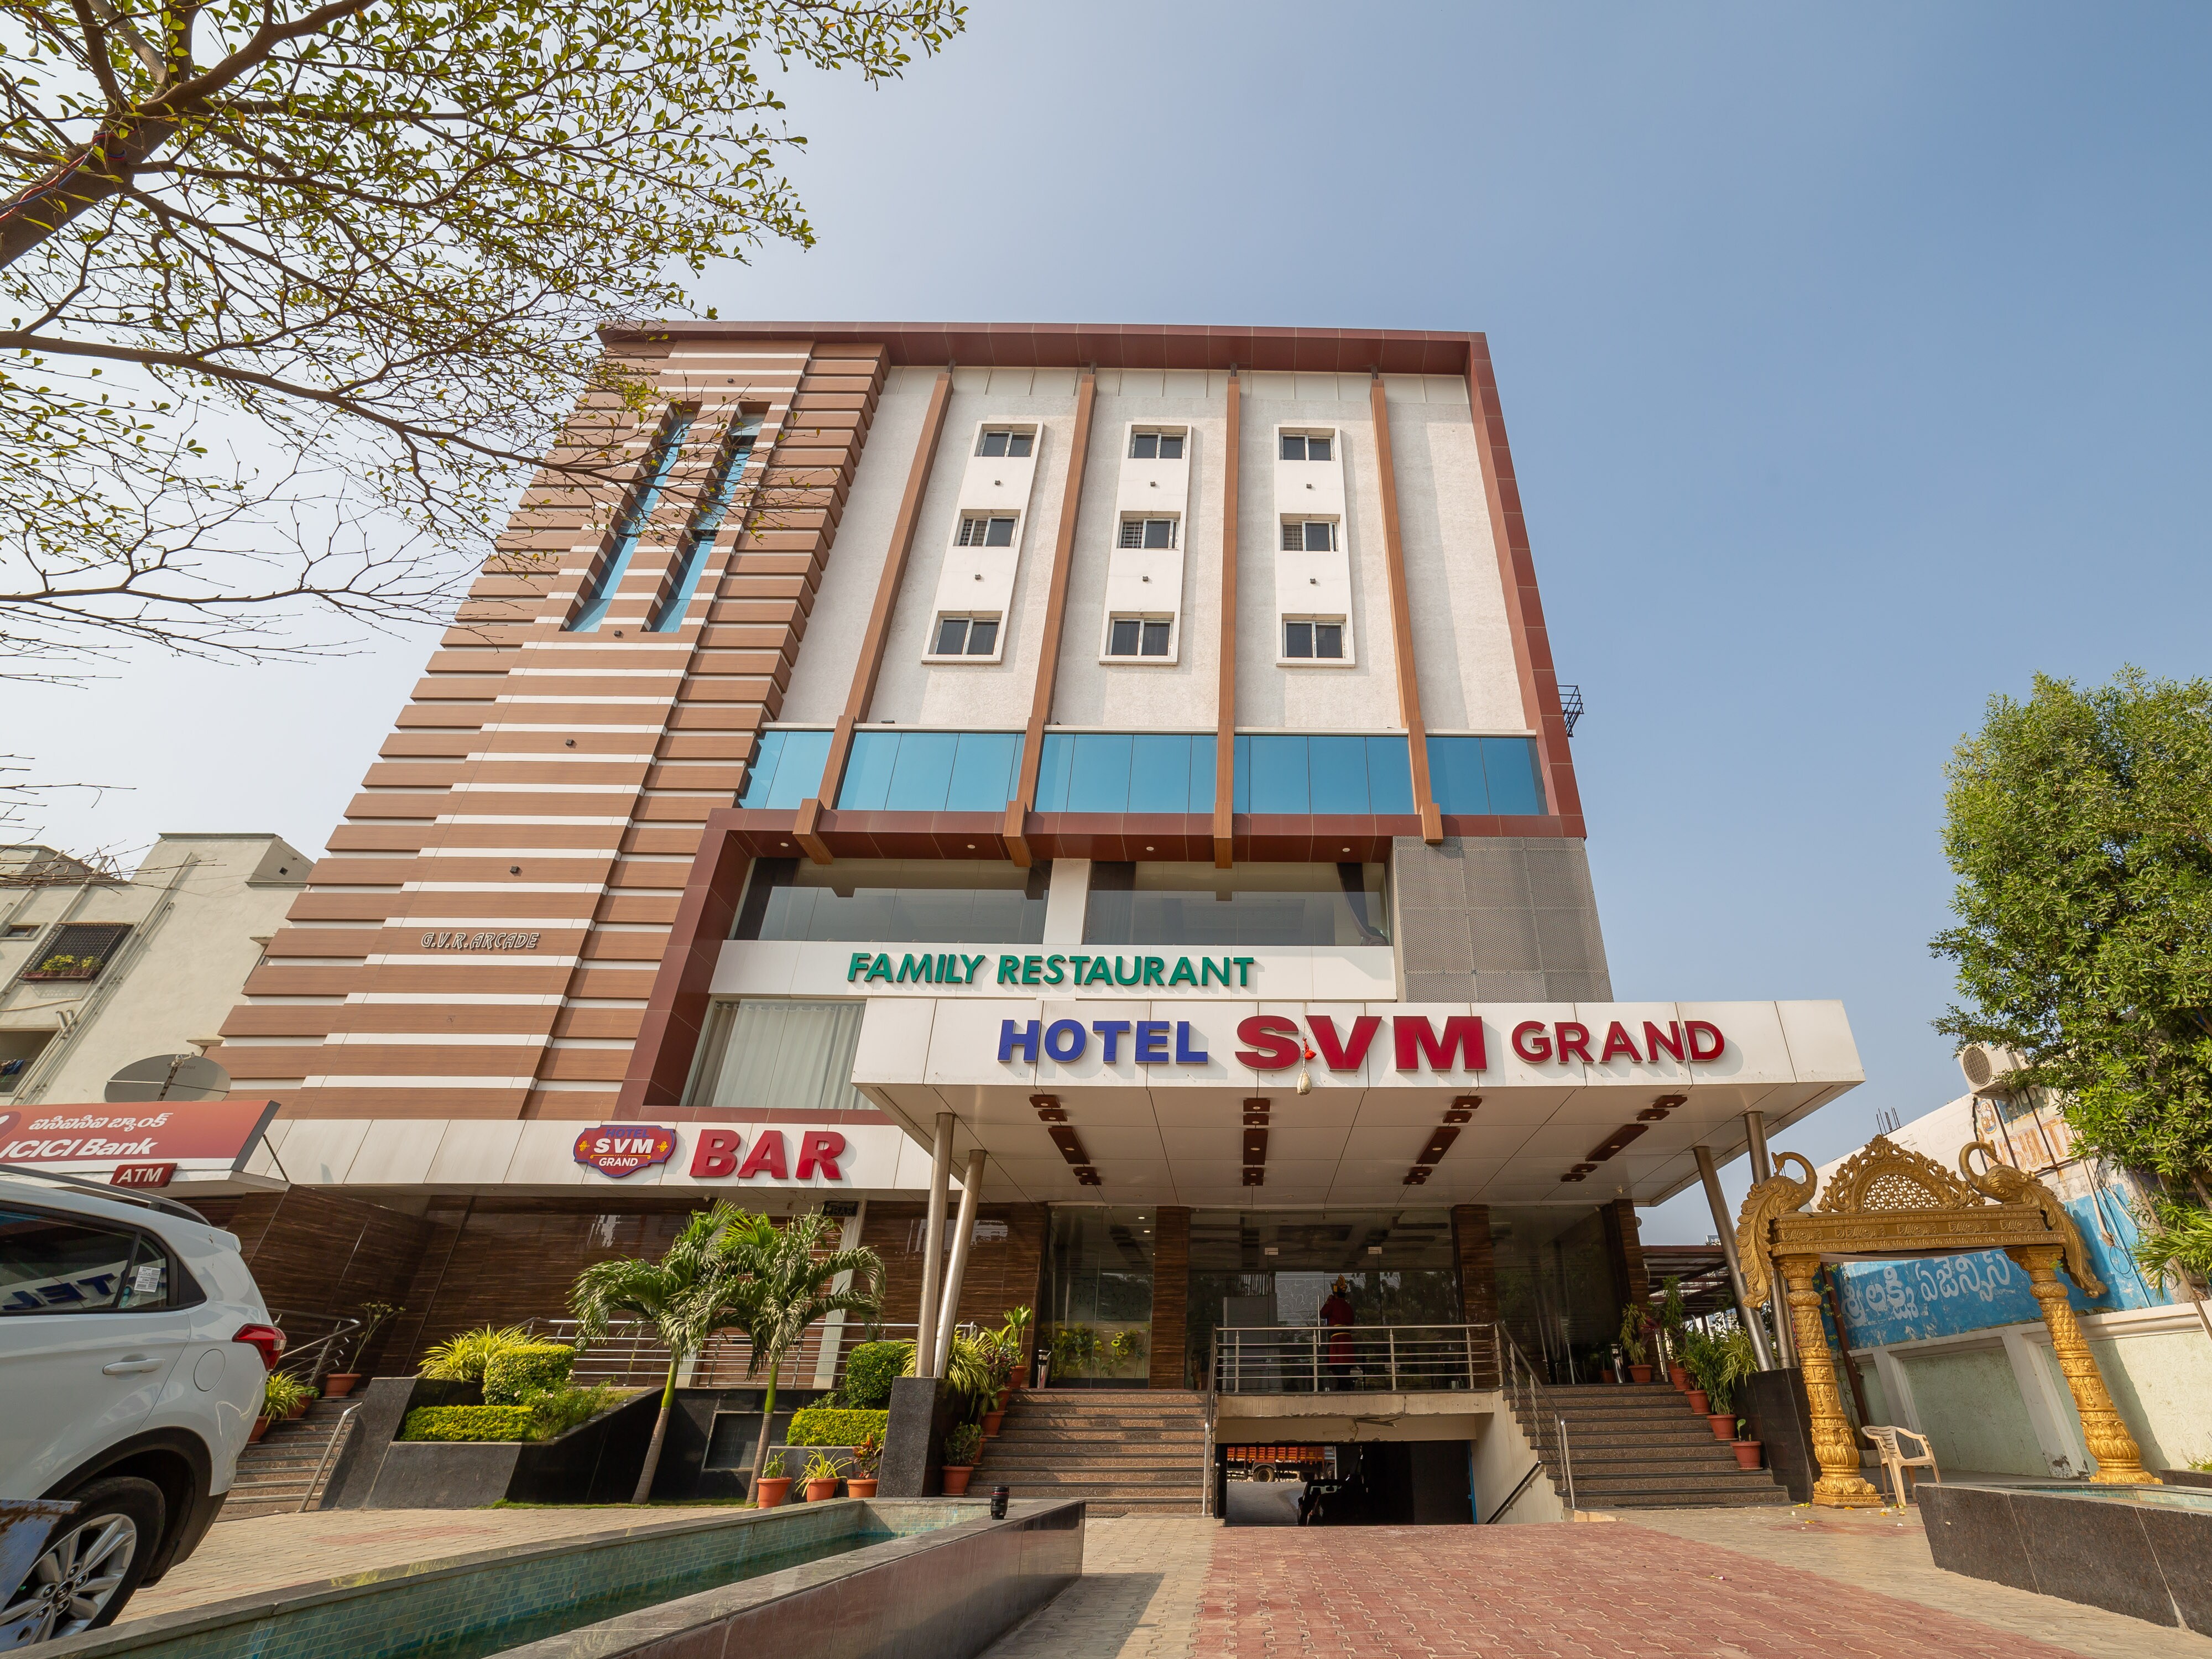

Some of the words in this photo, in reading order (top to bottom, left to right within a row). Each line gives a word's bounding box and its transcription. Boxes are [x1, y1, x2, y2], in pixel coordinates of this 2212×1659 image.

[847, 952, 985, 984] FAMILY
[997, 954, 1254, 987] RESTAURANT
[998, 1019, 1208, 1065] HOTEL
[1234, 1014, 1488, 1072] SVM
[1511, 1020, 1725, 1064] GRAND
[606, 1129, 650, 1138] HOTEL
[0, 1139, 83, 1159] ICICI
[75, 1138, 159, 1157] Bank
[593, 1138, 655, 1154] SVM
[599, 1157, 638, 1167] GRAND
[690, 1129, 846, 1180] BAR
[117, 1167, 164, 1183] ATM
[832, 1206, 853, 1216] BAR
